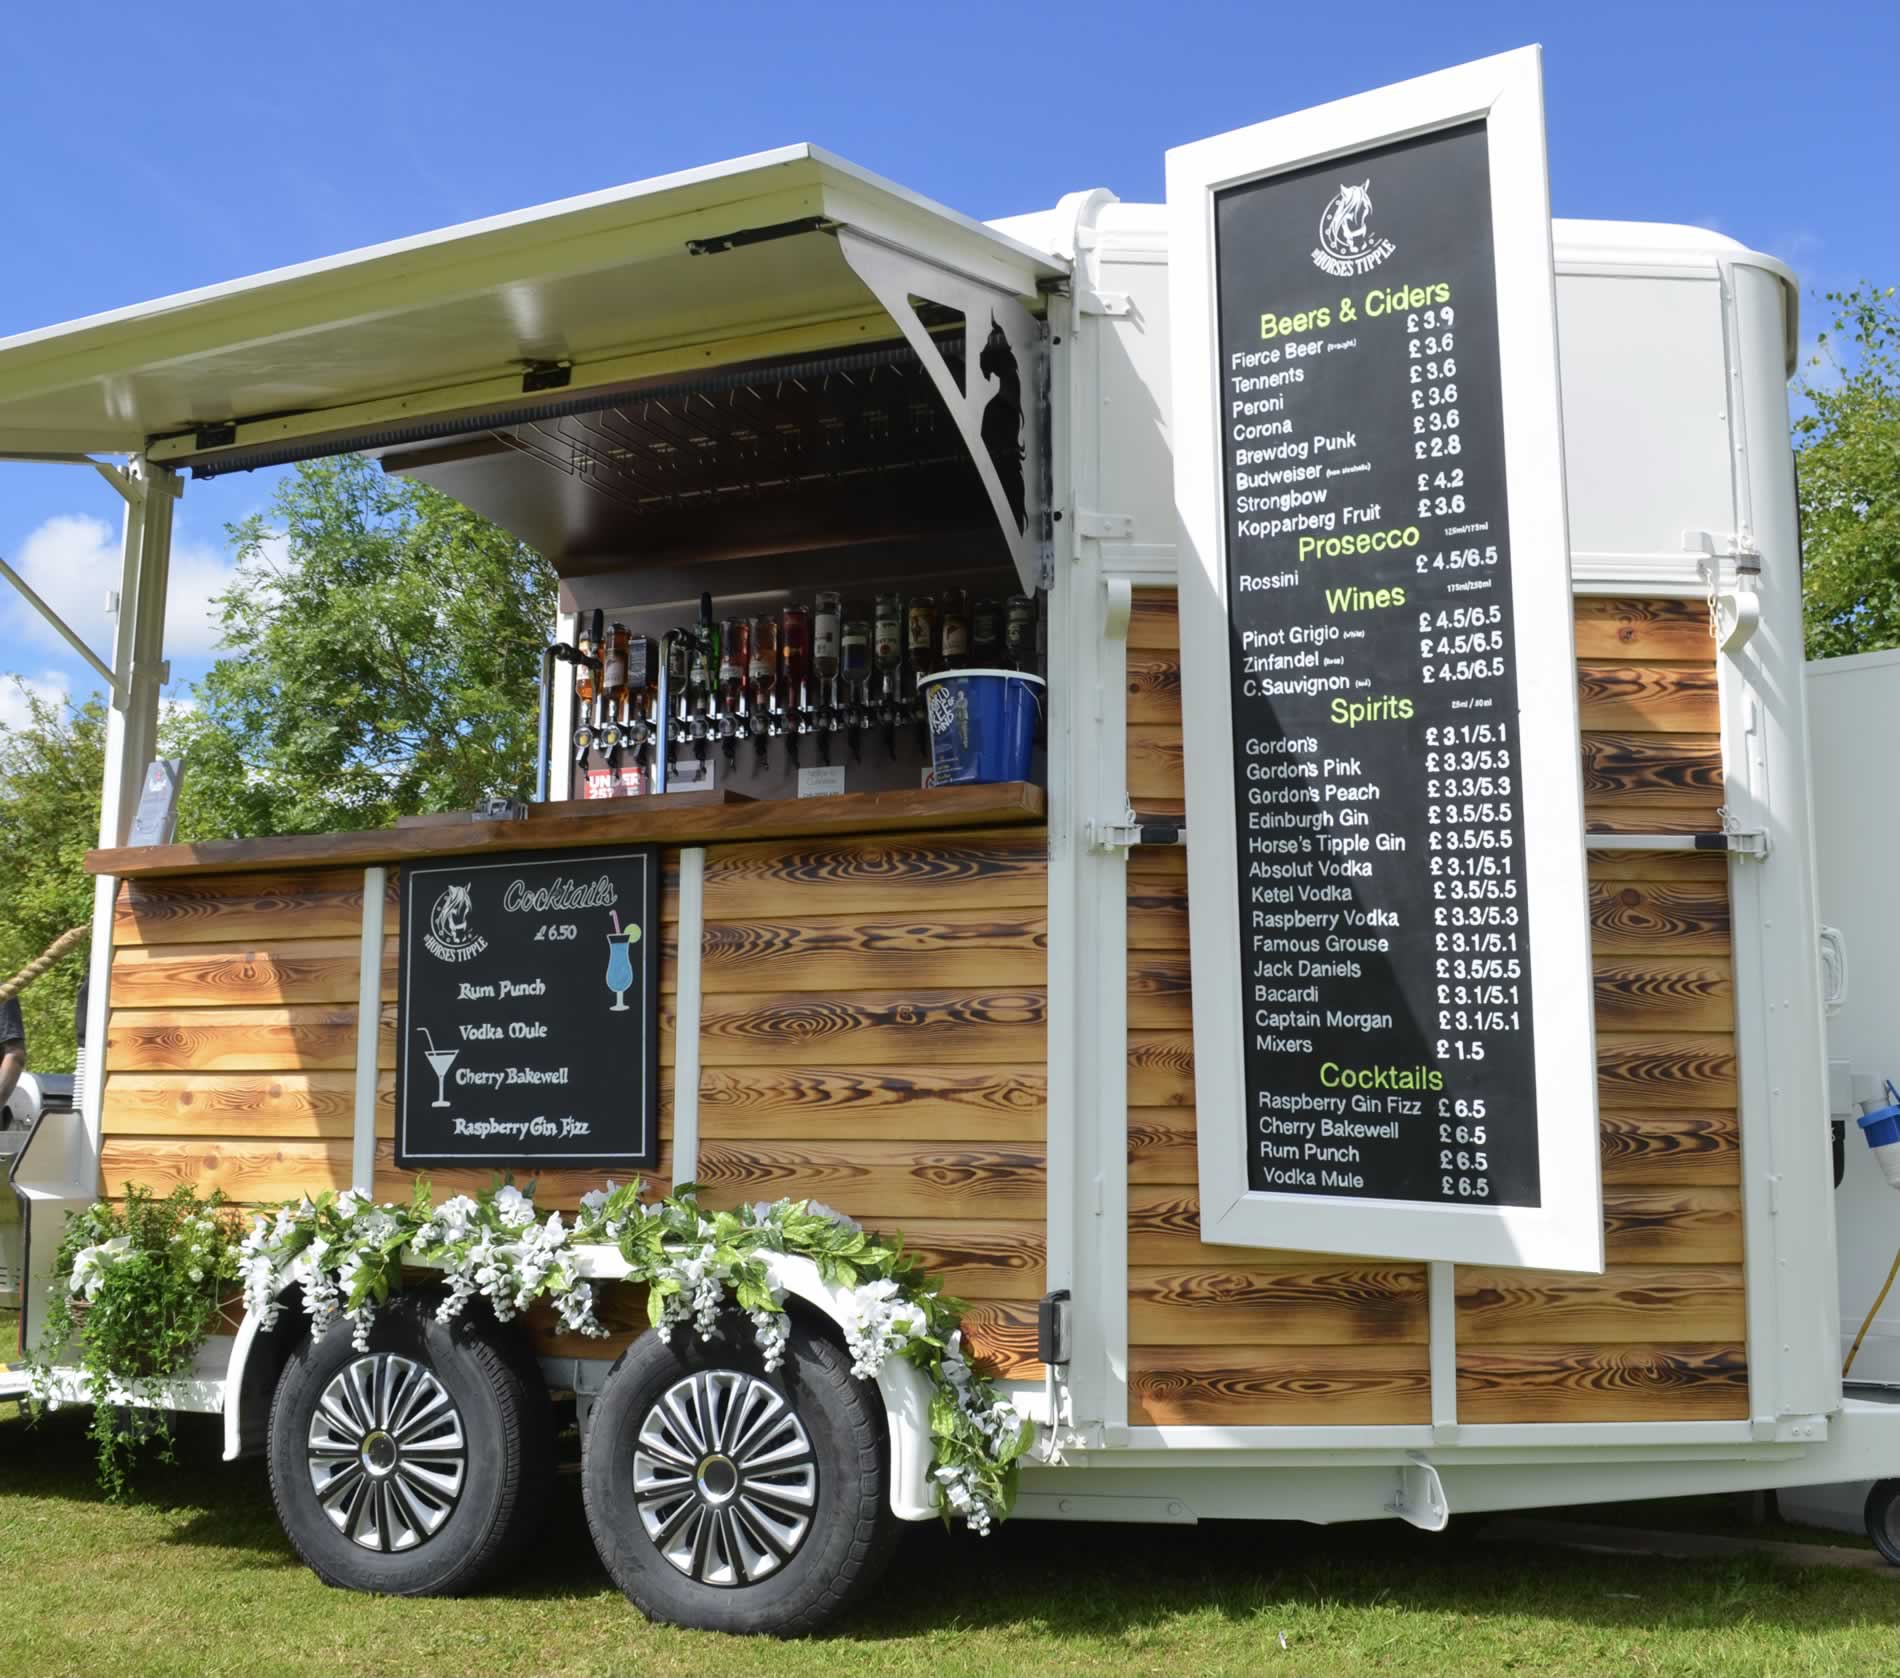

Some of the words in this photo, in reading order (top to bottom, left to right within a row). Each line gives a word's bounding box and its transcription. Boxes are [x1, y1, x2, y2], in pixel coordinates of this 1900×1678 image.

[1355, 239, 1396, 275] TIPPLE
[1262, 308, 1330, 339] Beers
[1340, 298, 1357, 322] &
[1366, 283, 1450, 316] Ciders
[1232, 349, 1280, 370] Fierce
[1285, 341, 1323, 359] Beer
[1424, 306, 1454, 328] 3.9
[1232, 368, 1304, 392] Tennents
[1425, 333, 1453, 354] 3.6
[1233, 393, 1283, 418] Peroni
[1427, 358, 1456, 379] 3.6
[1234, 420, 1292, 440] Corona
[1429, 384, 1457, 405] 3.6
[1236, 442, 1308, 465] Brewdog
[1314, 432, 1356, 453] Punk
[1430, 409, 1459, 431] 3.6
[1236, 465, 1322, 490] Budweiser
[1431, 434, 1461, 456] 2.8
[1237, 489, 1327, 513] Strongbow
[1434, 469, 1463, 488] 4.2
[1238, 513, 1335, 538] Kopparberg
[1344, 504, 1381, 524] Fruit
[1435, 495, 1465, 515] 3.6
[1300, 527, 1419, 560] Prosecco
[1240, 570, 1298, 591] Rossini
[1433, 546, 1497, 570] 4.5/6.5
[1326, 587, 1405, 613] Wines
[1243, 630, 1284, 650] Pinot
[1290, 625, 1339, 645] Grigio
[1436, 606, 1501, 629] 4.5/6.5
[1244, 651, 1318, 672] Zinfandel
[1437, 631, 1502, 654] 4.5/6.5
[1245, 676, 1349, 696] C.Sauvignon
[1439, 657, 1504, 681] 4.5/6.5
[1331, 696, 1414, 728] Spirits
[1247, 736, 1318, 754] Gordon's
[1444, 723, 1506, 745] 3.1/5.1
[1247, 762, 1318, 779] Gordon's
[1324, 758, 1361, 777] Pink
[1444, 750, 1509, 771] 3.3/5.3
[1249, 786, 1320, 804] Gordon's
[1326, 783, 1379, 801] Peach
[1445, 776, 1510, 797] 3.3/5.3
[1250, 810, 1334, 830] Edinburgh
[1340, 809, 1368, 826] Gin
[1446, 803, 1512, 823] 3.5/5.5
[1250, 836, 1312, 853] Horse's
[1317, 834, 1369, 855] Tipple
[1376, 834, 1405, 850] Gin
[1447, 830, 1512, 850] 3.5/5.5
[1249, 862, 1313, 878] Absolut
[1319, 860, 1372, 876] Vodka
[1448, 856, 1510, 876] 3.1/5.1
[504, 875, 618, 912] Cocktails
[1252, 886, 1293, 903] Ketel
[1298, 885, 1352, 901] Vodka
[1451, 880, 1516, 899] 3.5/5.5
[1253, 910, 1339, 930] Raspberry
[1344, 909, 1399, 926] Vodka
[1452, 906, 1518, 926] 3.3/5.3
[425, 933, 456, 963] HORSES
[457, 937, 488, 962] TIPPLE
[1254, 936, 1320, 952] Famous
[1326, 935, 1389, 952] Grouse
[1453, 933, 1516, 952] 3.1/5.1
[1254, 960, 1293, 976] Jack
[1299, 960, 1361, 977] Daniels
[1454, 959, 1520, 979] 3.5/5.5
[458, 983, 494, 1000] Rum
[499, 979, 545, 999] Punch
[1256, 985, 1318, 1002] Bacardi
[1455, 986, 1518, 1004] 3.1/5.1
[459, 1024, 504, 1040] Vodka
[509, 1022, 547, 1038] Mule
[1256, 1010, 1320, 1030] Captain
[1327, 1011, 1392, 1032] Morgan
[1456, 1011, 1519, 1030] 3.1/5.1
[1257, 1035, 1312, 1052] Mixers
[1455, 1041, 1484, 1060] 1.5
[456, 1068, 504, 1090] Cherry
[506, 1068, 568, 1084] Bakewell
[1320, 1062, 1442, 1090] Cocktails
[1260, 1092, 1346, 1114] Raspberry
[1352, 1095, 1381, 1112] Gin
[1388, 1096, 1421, 1114] Fizz
[1455, 1100, 1485, 1118] 6.5
[453, 1118, 529, 1140] Raspberry
[530, 1116, 557, 1136] Gin
[559, 1116, 590, 1138] Fizz
[1260, 1117, 1315, 1138] Cherry
[1322, 1119, 1398, 1138] Bakewell
[1456, 1126, 1486, 1144] 6.5
[1261, 1142, 1299, 1159] Rum
[1305, 1144, 1359, 1162] Punch
[1457, 1152, 1488, 1170] 6.5
[1264, 1167, 1316, 1185] Vodka
[1322, 1170, 1363, 1188] Mule
[1459, 1177, 1488, 1196] 6.5
